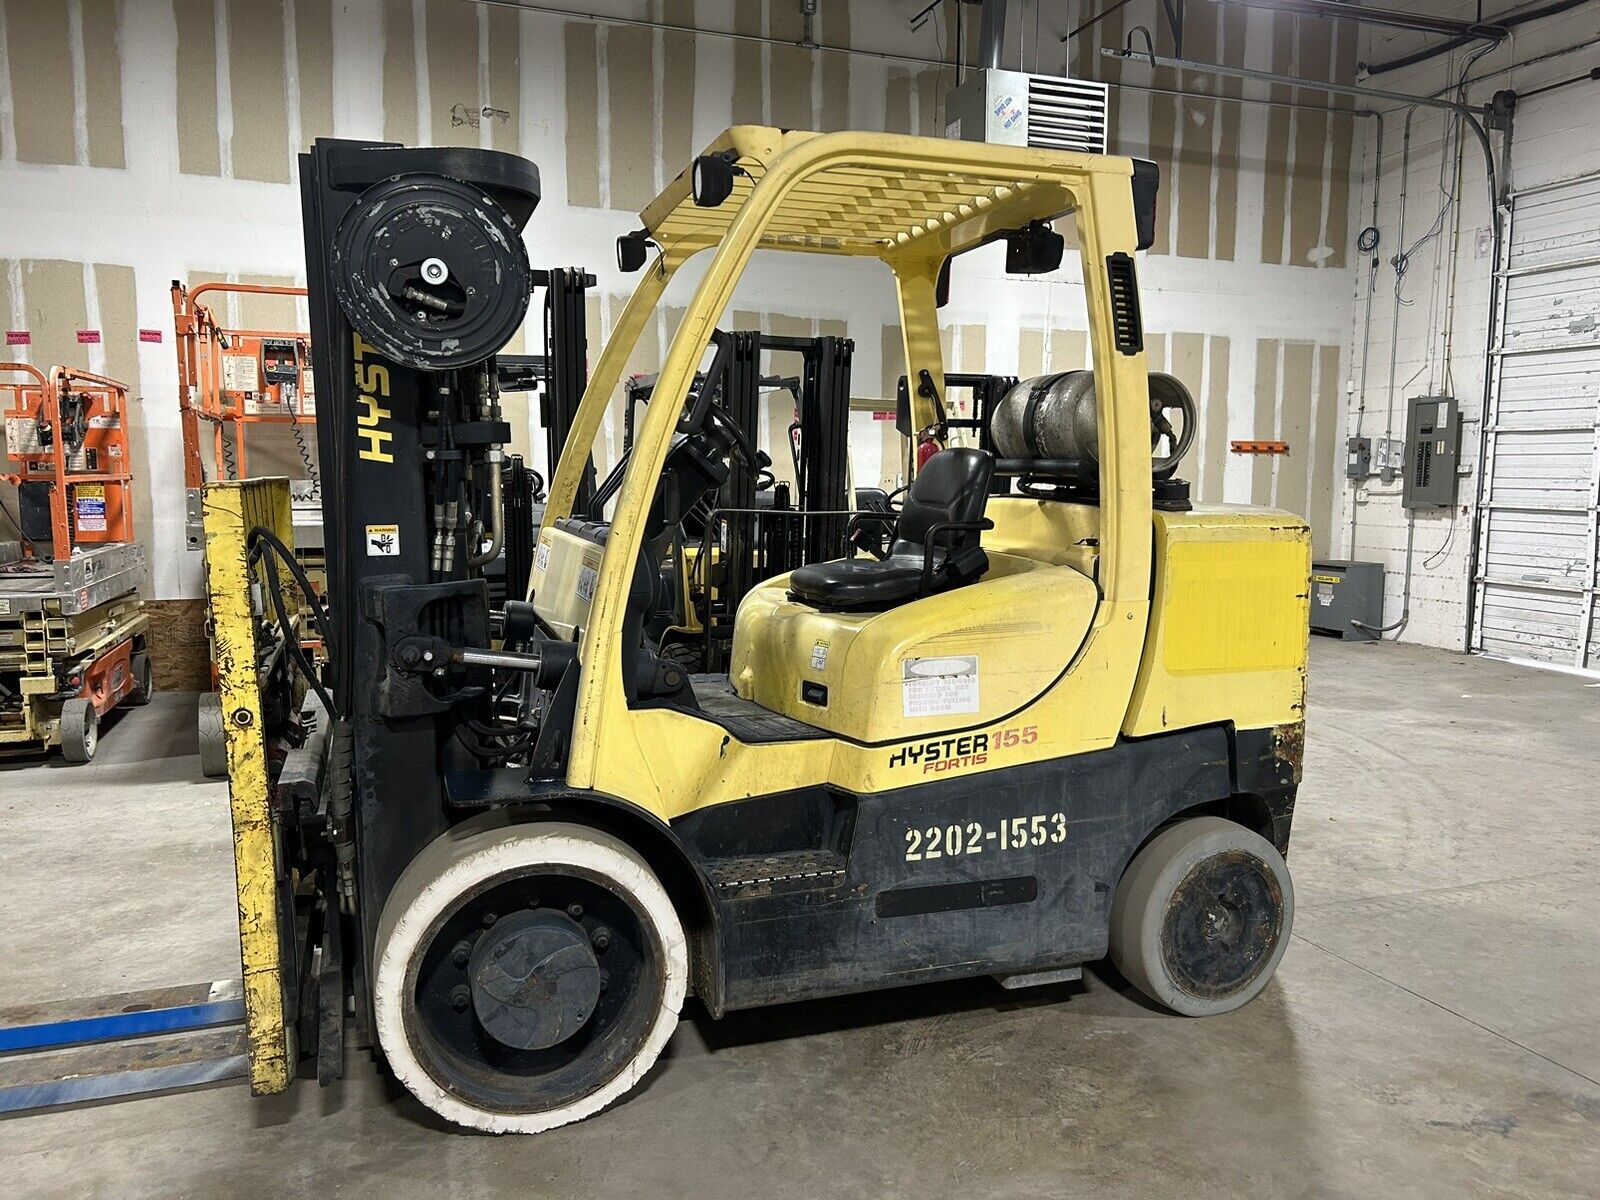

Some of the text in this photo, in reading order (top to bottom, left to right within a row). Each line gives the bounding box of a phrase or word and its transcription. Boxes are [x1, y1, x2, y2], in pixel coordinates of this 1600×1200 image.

[353, 332, 394, 463] HYST
[889, 725, 1039, 768] HYSTER 155
[923, 752, 988, 774] FORTIS
[905, 812, 1067, 862] 2202-1553
